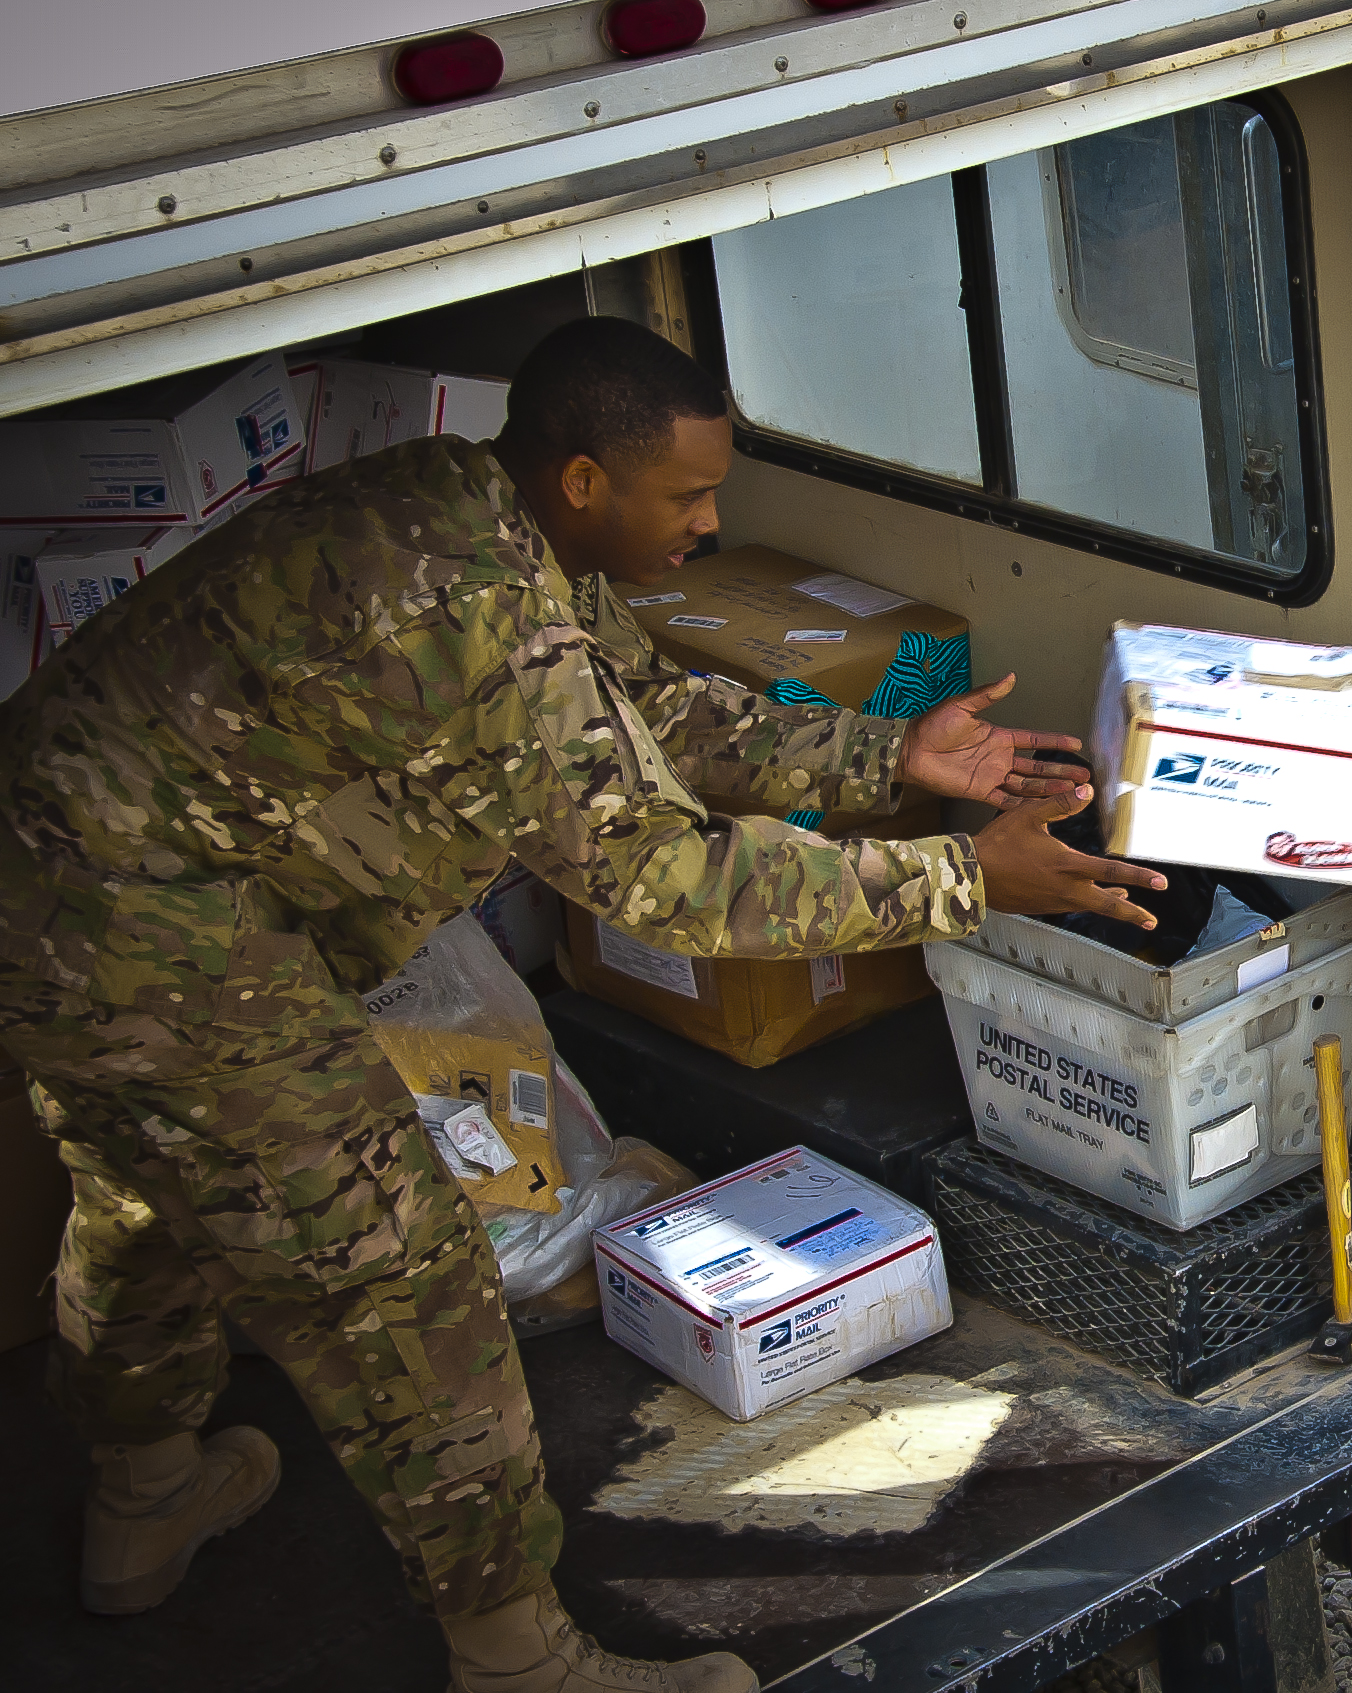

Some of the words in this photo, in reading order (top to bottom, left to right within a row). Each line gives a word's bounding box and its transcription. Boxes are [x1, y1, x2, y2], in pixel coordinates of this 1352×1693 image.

[976, 1049, 1055, 1104] POSTAL
[1059, 1087, 1151, 1144] SERVICE
[979, 1021, 1052, 1072] UNITED
[1056, 1057, 1138, 1109] STATES
[1025, 1107, 1049, 1128] FLAT
[1051, 1117, 1075, 1139] MAIL
[1076, 1130, 1104, 1151] TRAY
[795, 1322, 822, 1341] MAIL
